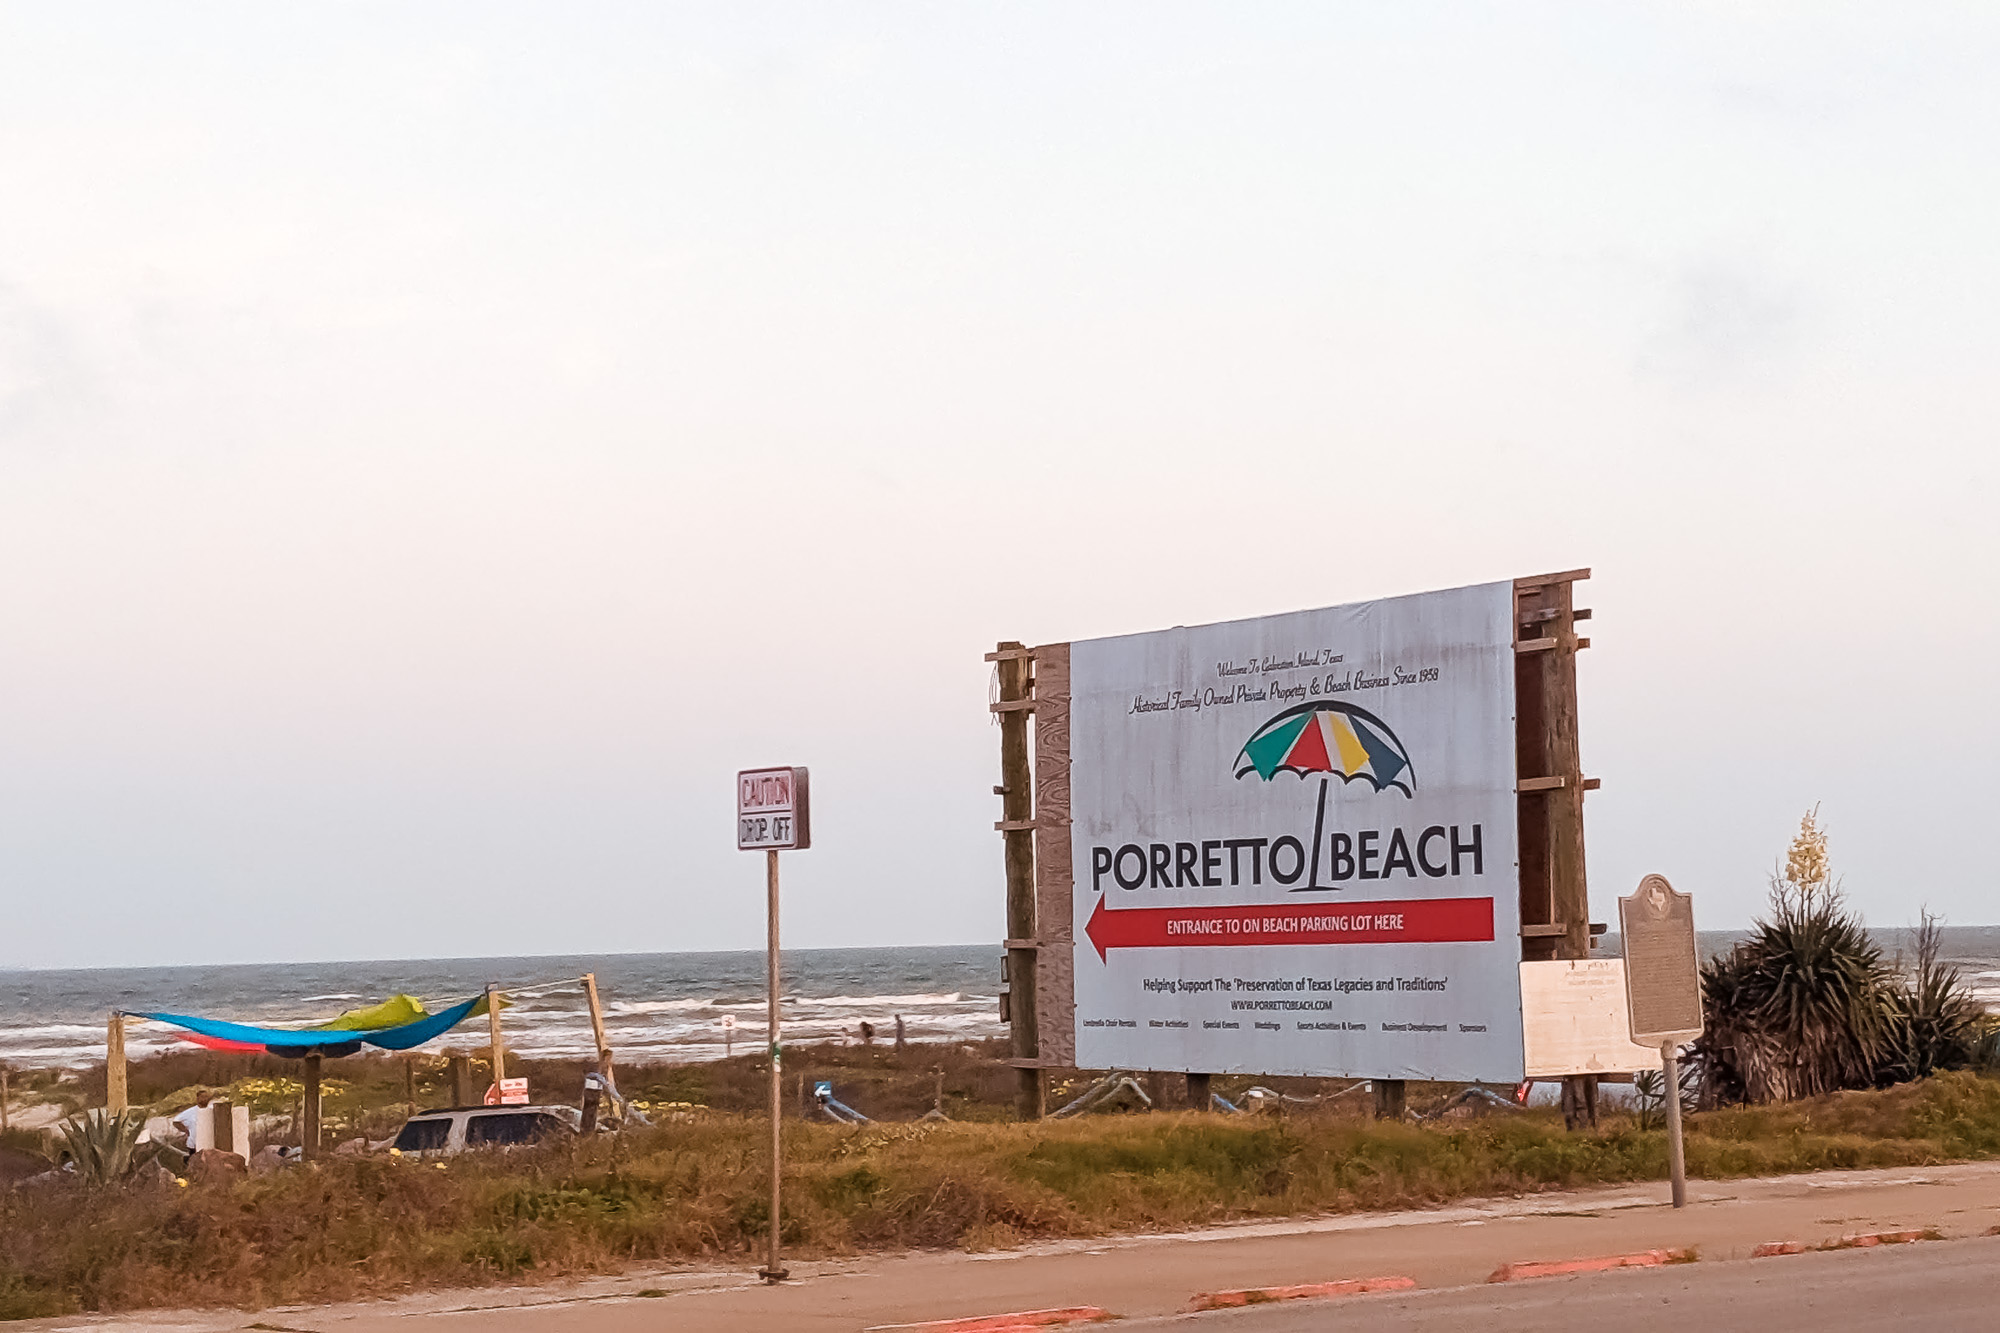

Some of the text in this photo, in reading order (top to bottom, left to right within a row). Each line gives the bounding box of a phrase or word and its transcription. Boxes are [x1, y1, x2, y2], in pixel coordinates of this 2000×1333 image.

[1249, 659, 1259, 674] To
[1204, 685, 1234, 706] Owned
[1237, 684, 1266, 703] Private
[1269, 680, 1306, 703] Property
[1310, 677, 1321, 695] &
[1324, 671, 1351, 694] Beach
[1354, 670, 1389, 690] Business
[1392, 665, 1416, 686] Since
[741, 816, 792, 842] DROP OFF
[1092, 824, 1483, 891] PORRETTO BEACH
[1167, 914, 1404, 935] ENTRANCE TO ON BEACH PARKING LOT HERE
[1143, 978, 1176, 993] Helping
[1177, 978, 1213, 994] Support
[1215, 978, 1232, 991] The
[1295, 977, 1306, 991] of
[1306, 978, 1332, 991] Texas
[1334, 978, 1374, 994] Legacies
[1375, 977, 1394, 991] and
